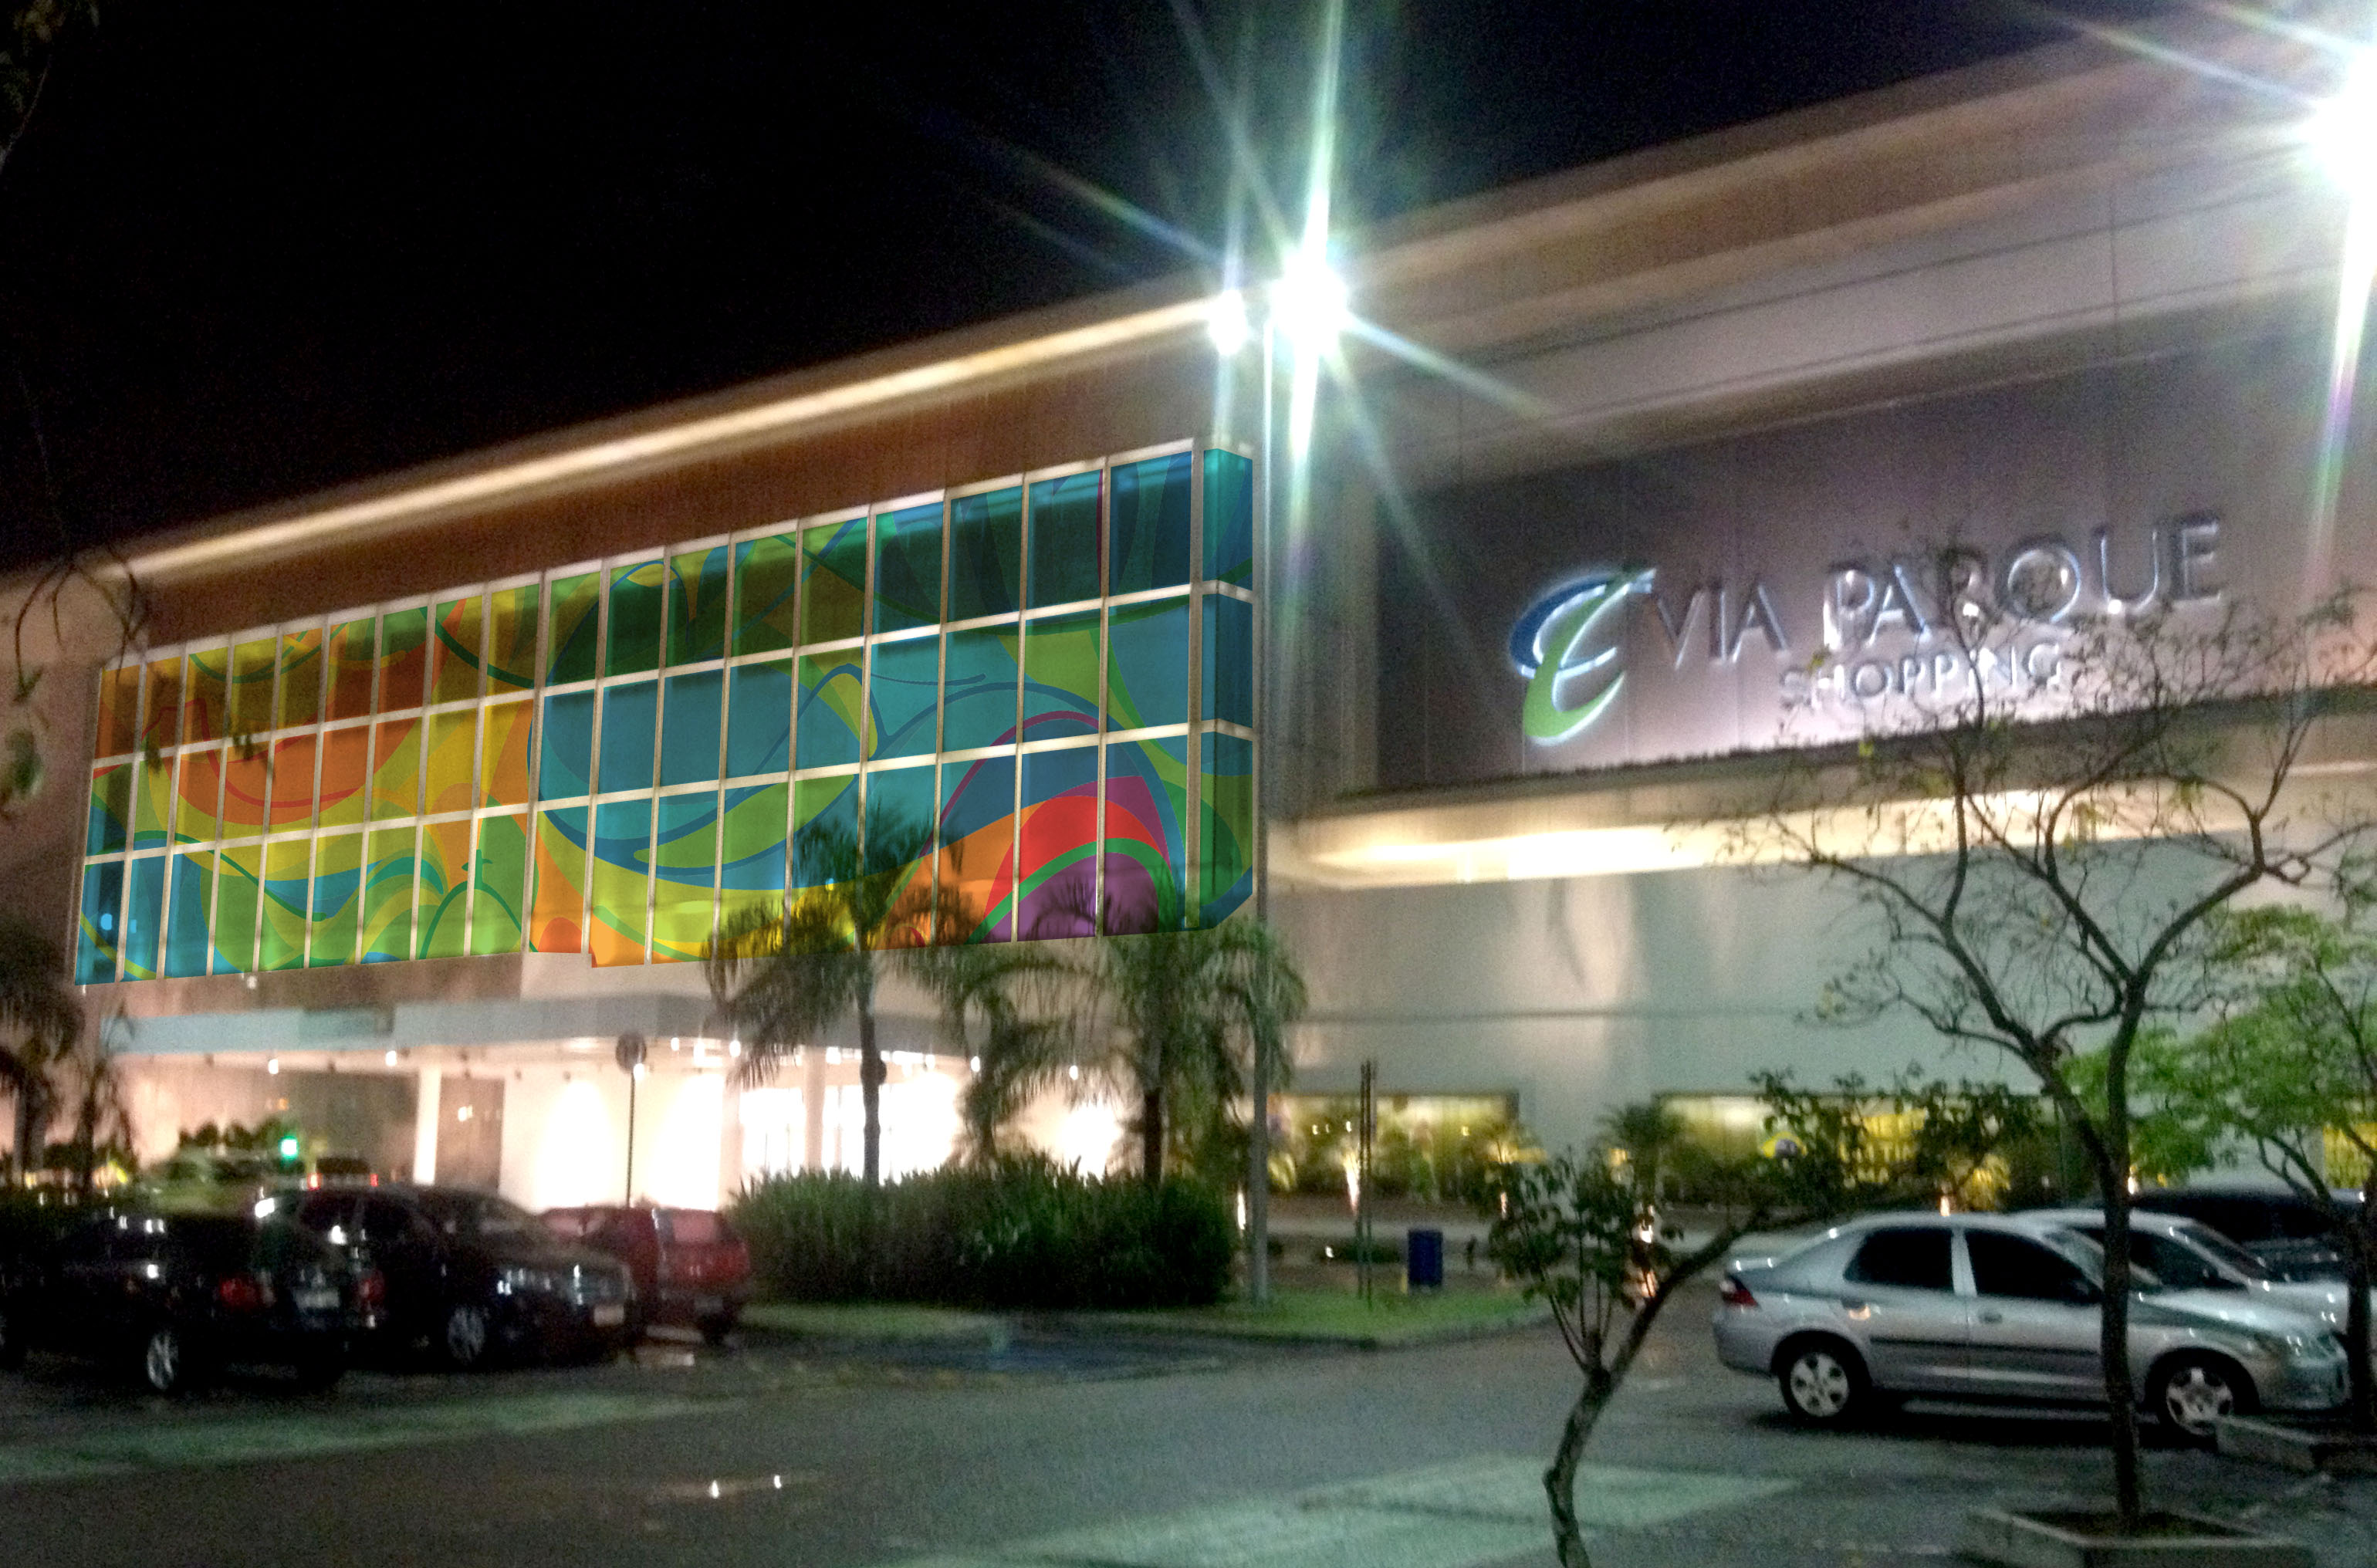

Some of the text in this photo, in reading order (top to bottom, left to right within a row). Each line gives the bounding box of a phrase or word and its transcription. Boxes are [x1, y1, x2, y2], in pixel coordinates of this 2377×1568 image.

[1648, 511, 2220, 669] VIA PARQUE
[1779, 640, 2062, 710] SHOPPING
